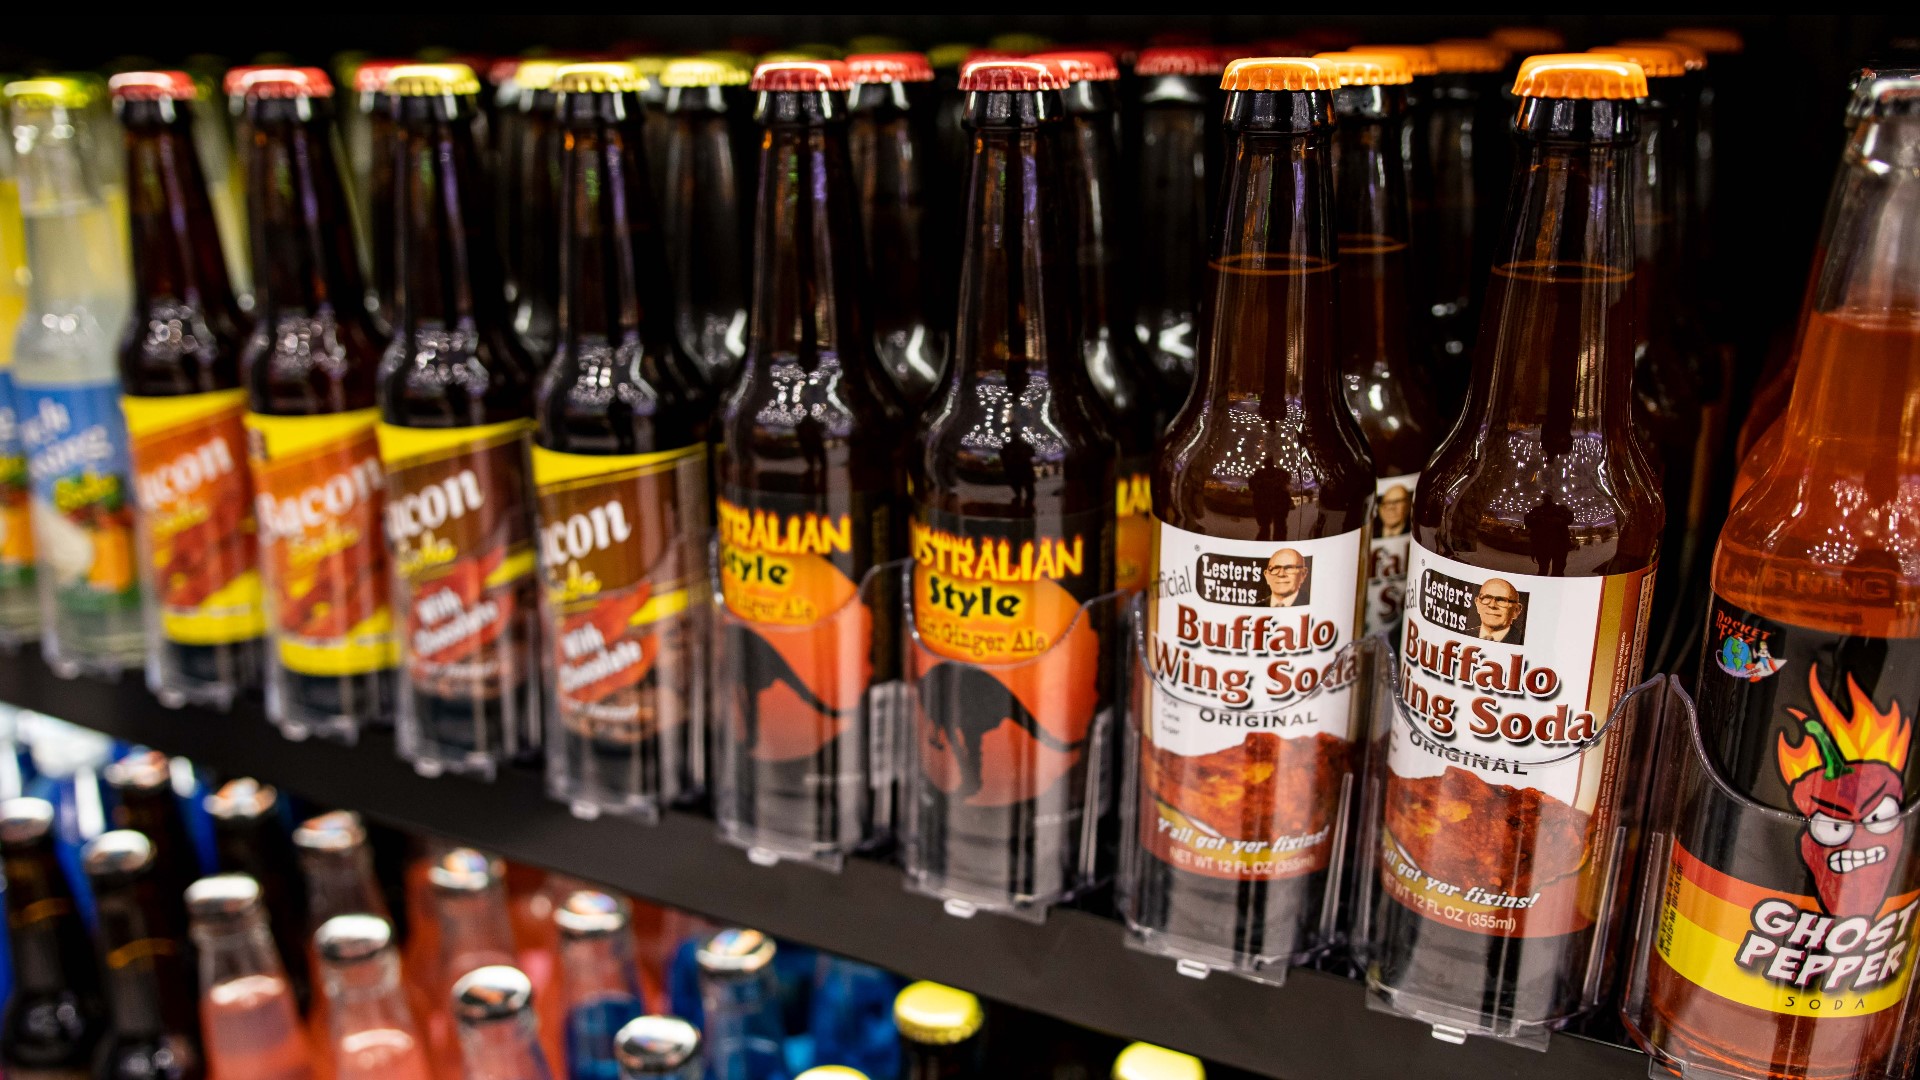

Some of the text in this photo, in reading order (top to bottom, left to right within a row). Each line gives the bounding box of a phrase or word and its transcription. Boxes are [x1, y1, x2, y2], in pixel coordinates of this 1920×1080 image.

[1201, 555, 1262, 582] Lester's
[929, 576, 1021, 618] Style
[1203, 579, 1258, 605] Fixins
[1423, 570, 1474, 609] Lester's
[1177, 603, 1337, 654] Buffalo
[1423, 598, 1468, 632] Fixins
[1011, 629, 1046, 653] Ale
[1404, 617, 1559, 696] Buffalo
[1152, 635, 1359, 706] Wing Soda
[1199, 707, 1319, 729] ORIGINAL
[1469, 695, 1597, 744] Soda
[1409, 730, 1529, 776] ORIGINAL
[1157, 816, 1331, 855] Y'all get yer fixins!
[1194, 855, 1213, 870] WT
[1217, 860, 1232, 874] 12
[1234, 860, 1249, 875] FL
[1252, 861, 1273, 875] OZ
[1398, 862, 1422, 883] get
[1425, 876, 1461, 897] yer
[1464, 885, 1541, 910] fixins!
[1413, 892, 1425, 909] 12
[1427, 898, 1442, 916] FL
[1444, 905, 1465, 923] OZ
[1467, 911, 1517, 933] (355ml)
[1753, 899, 1920, 956] GHOST
[1738, 932, 1908, 991] PEPPER
[1784, 995, 1866, 1011] SODA
